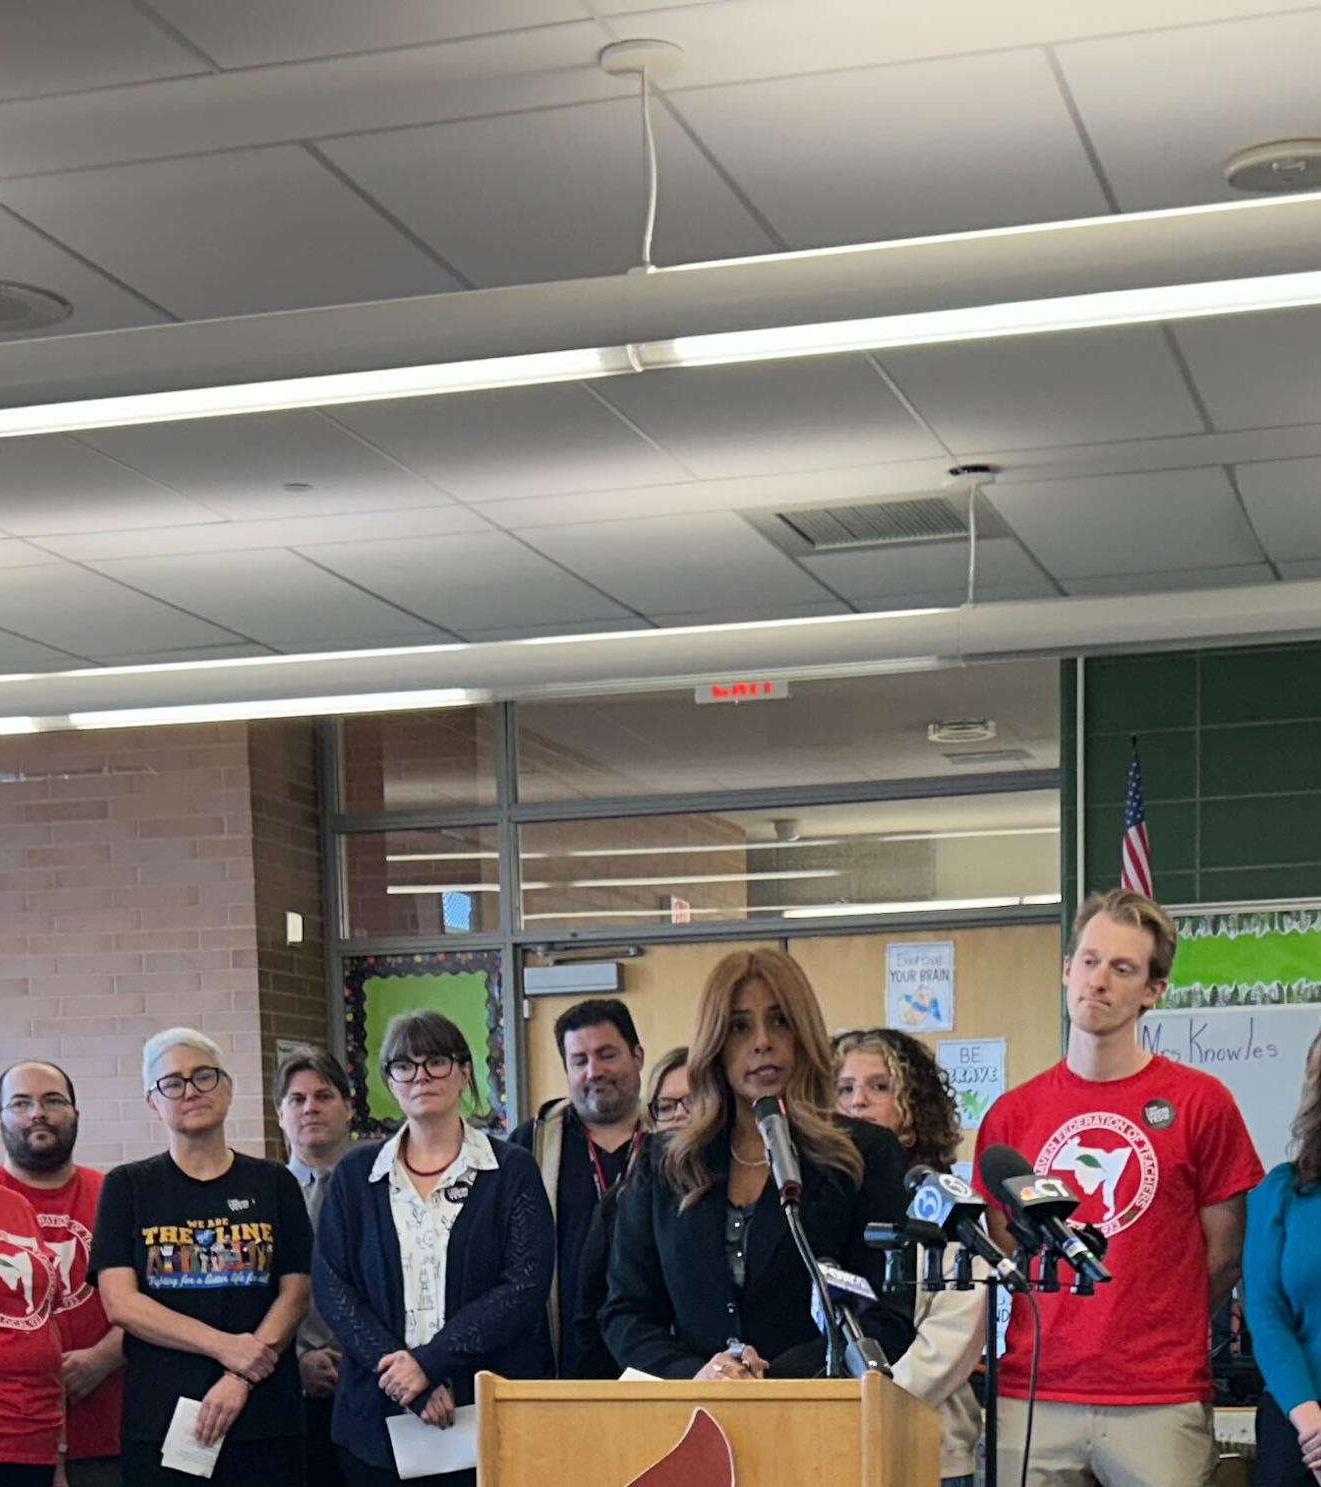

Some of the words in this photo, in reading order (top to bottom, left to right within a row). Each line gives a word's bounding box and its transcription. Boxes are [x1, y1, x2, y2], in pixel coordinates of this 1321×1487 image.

[889, 969, 917, 983] YOUR
[920, 969, 950, 982] BRAIN
[1189, 1017, 1279, 1063] Knowles
[960, 1047, 982, 1063] BE
[1056, 1115, 1128, 1141] FEDERATION
[1136, 1145, 1157, 1210] TEACHERS
[186, 1220, 205, 1228] WE
[207, 1218, 229, 1227] ARE
[142, 1226, 194, 1245] THE
[215, 1222, 274, 1244] LINE
